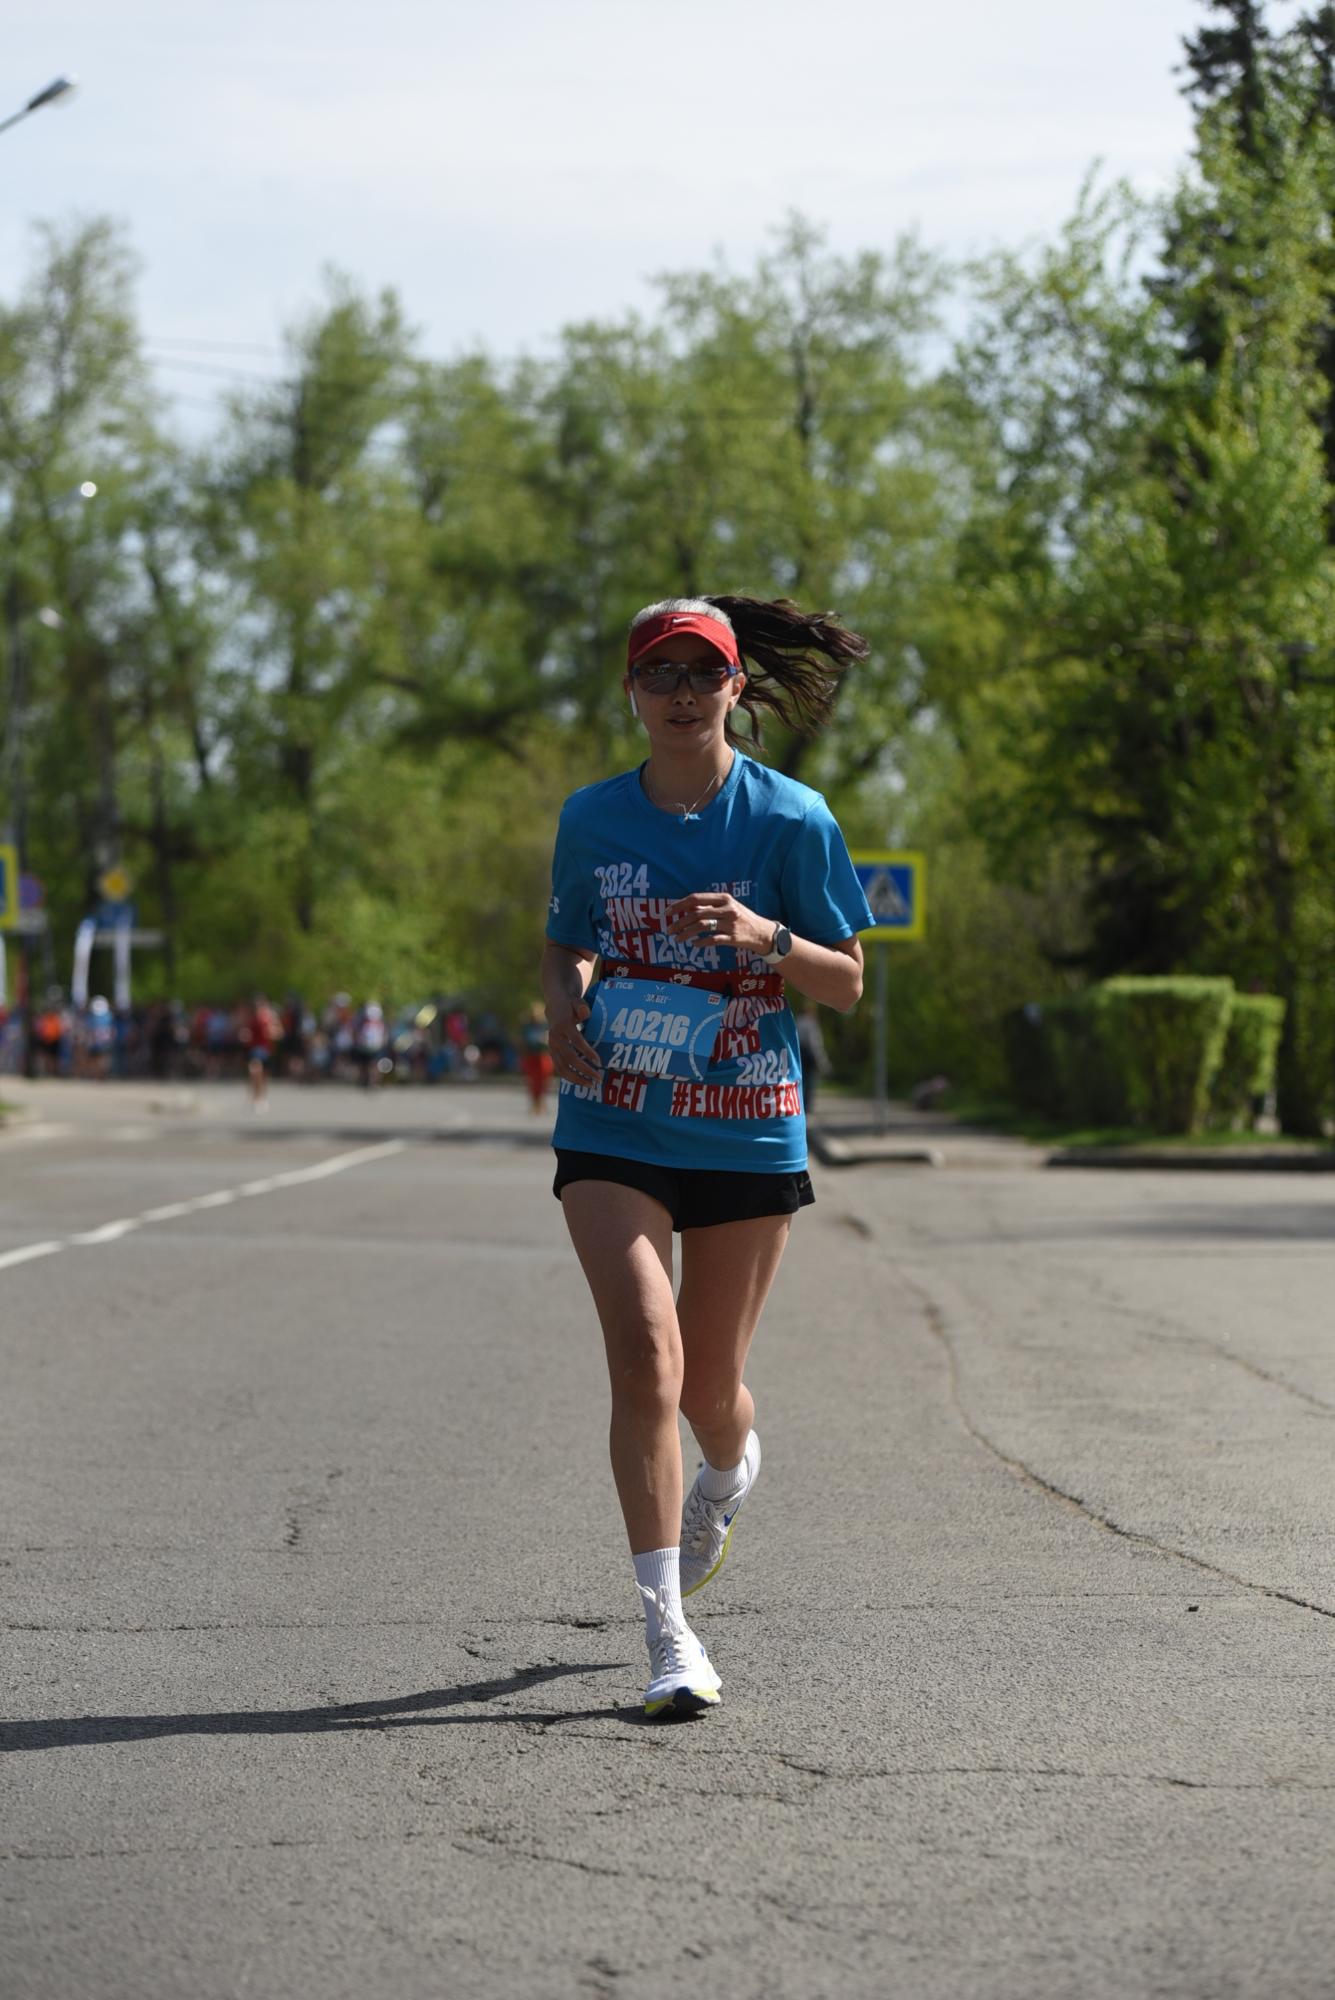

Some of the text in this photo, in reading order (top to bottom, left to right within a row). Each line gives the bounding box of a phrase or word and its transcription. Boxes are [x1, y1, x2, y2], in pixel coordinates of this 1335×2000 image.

[594, 862, 650, 898] 2024
[610, 1007, 690, 1046] 40216
[736, 1050, 790, 1086] 2024
